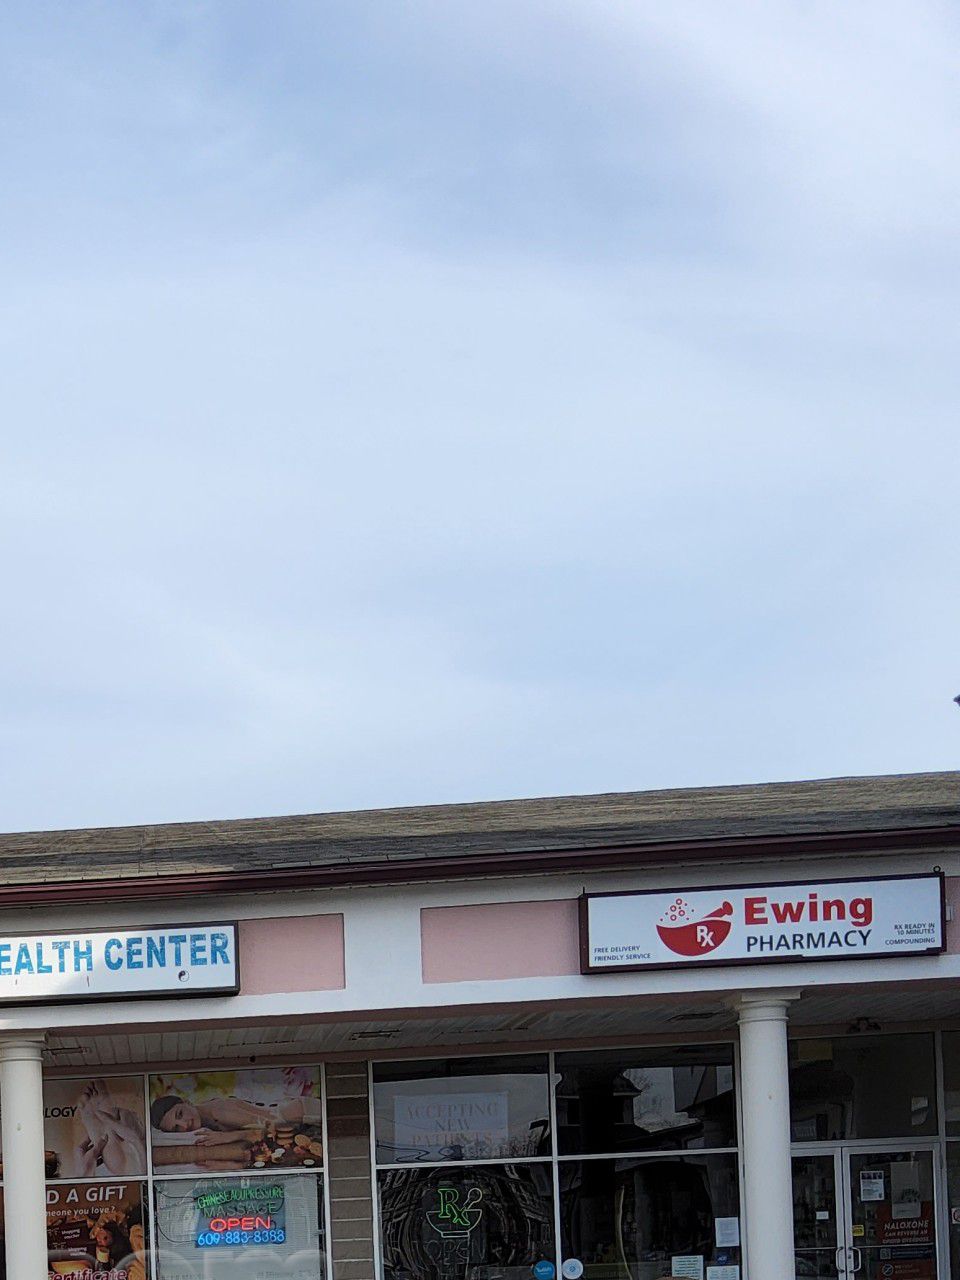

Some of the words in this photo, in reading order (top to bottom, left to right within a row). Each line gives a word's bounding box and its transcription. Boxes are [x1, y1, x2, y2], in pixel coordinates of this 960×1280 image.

[744, 893, 874, 927] Ewing
[610, 945, 641, 953] DELIVERY
[746, 929, 873, 953] PHARMACY
[884, 937, 935, 946] COMPOUNDING
[103, 932, 231, 971] CENTER
[65, 1188, 79, 1204] A
[85, 1185, 127, 1202] GIFT
[73, 1208, 89, 1217] you
[203, 1200, 279, 1218] MASSAGE
[210, 1215, 271, 1232] OPEN
[884, 1220, 929, 1230] NALOXONE
